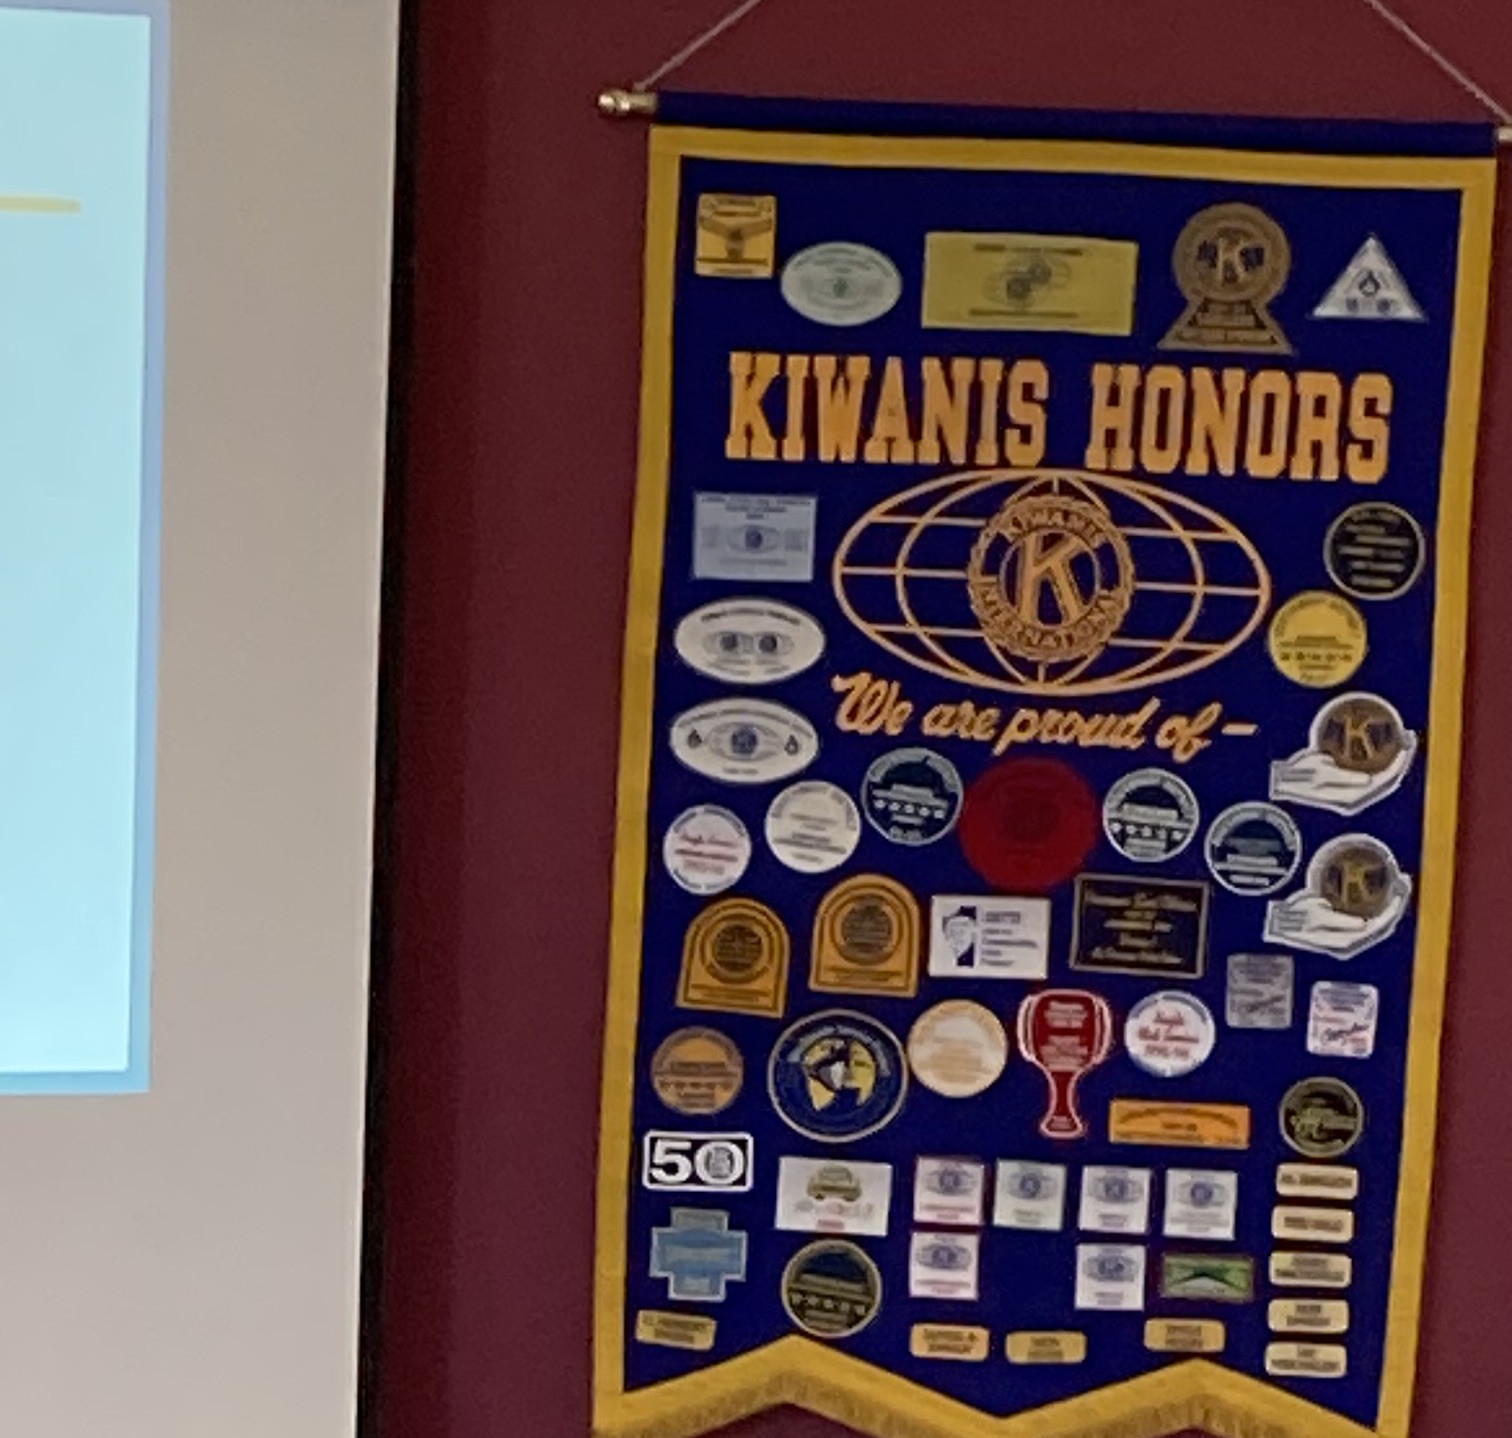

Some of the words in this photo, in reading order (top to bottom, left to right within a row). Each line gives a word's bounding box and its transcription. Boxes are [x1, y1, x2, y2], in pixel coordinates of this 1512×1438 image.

[725, 352, 1050, 467] KIWANIS
[1086, 362, 1393, 483] HONORS
[1018, 531, 1086, 627] K
[831, 671, 914, 735] We
[922, 700, 1001, 741] are
[992, 697, 1161, 757] proud
[1154, 701, 1223, 764] of
[651, 1138, 745, 1186] 50
